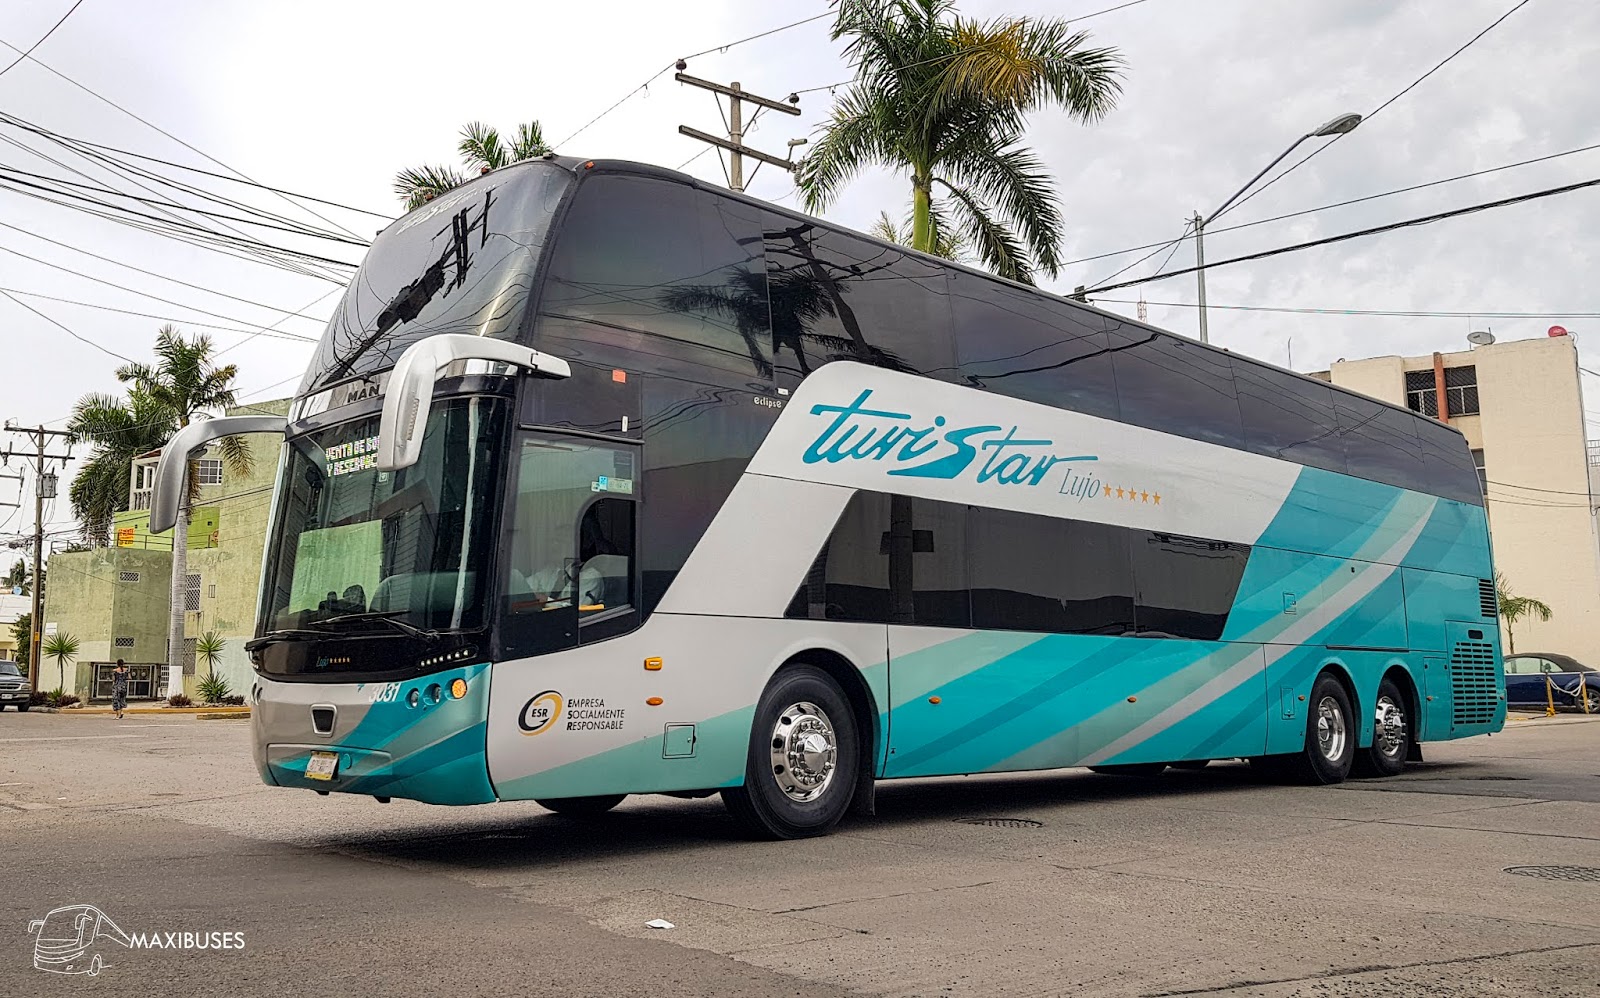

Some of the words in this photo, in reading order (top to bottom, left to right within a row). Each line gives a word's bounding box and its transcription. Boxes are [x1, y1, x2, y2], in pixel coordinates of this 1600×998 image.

[347, 384, 380, 403] MAN
[753, 396, 782, 409] eclipse
[1058, 467, 1101, 503] Lujo
[368, 683, 401, 702] 3031
[567, 698, 605, 708] EMPRESA
[531, 708, 548, 718] ESR
[567, 709, 625, 719] SOCIALMENTE
[566, 720, 624, 731] RESPONSABLE
